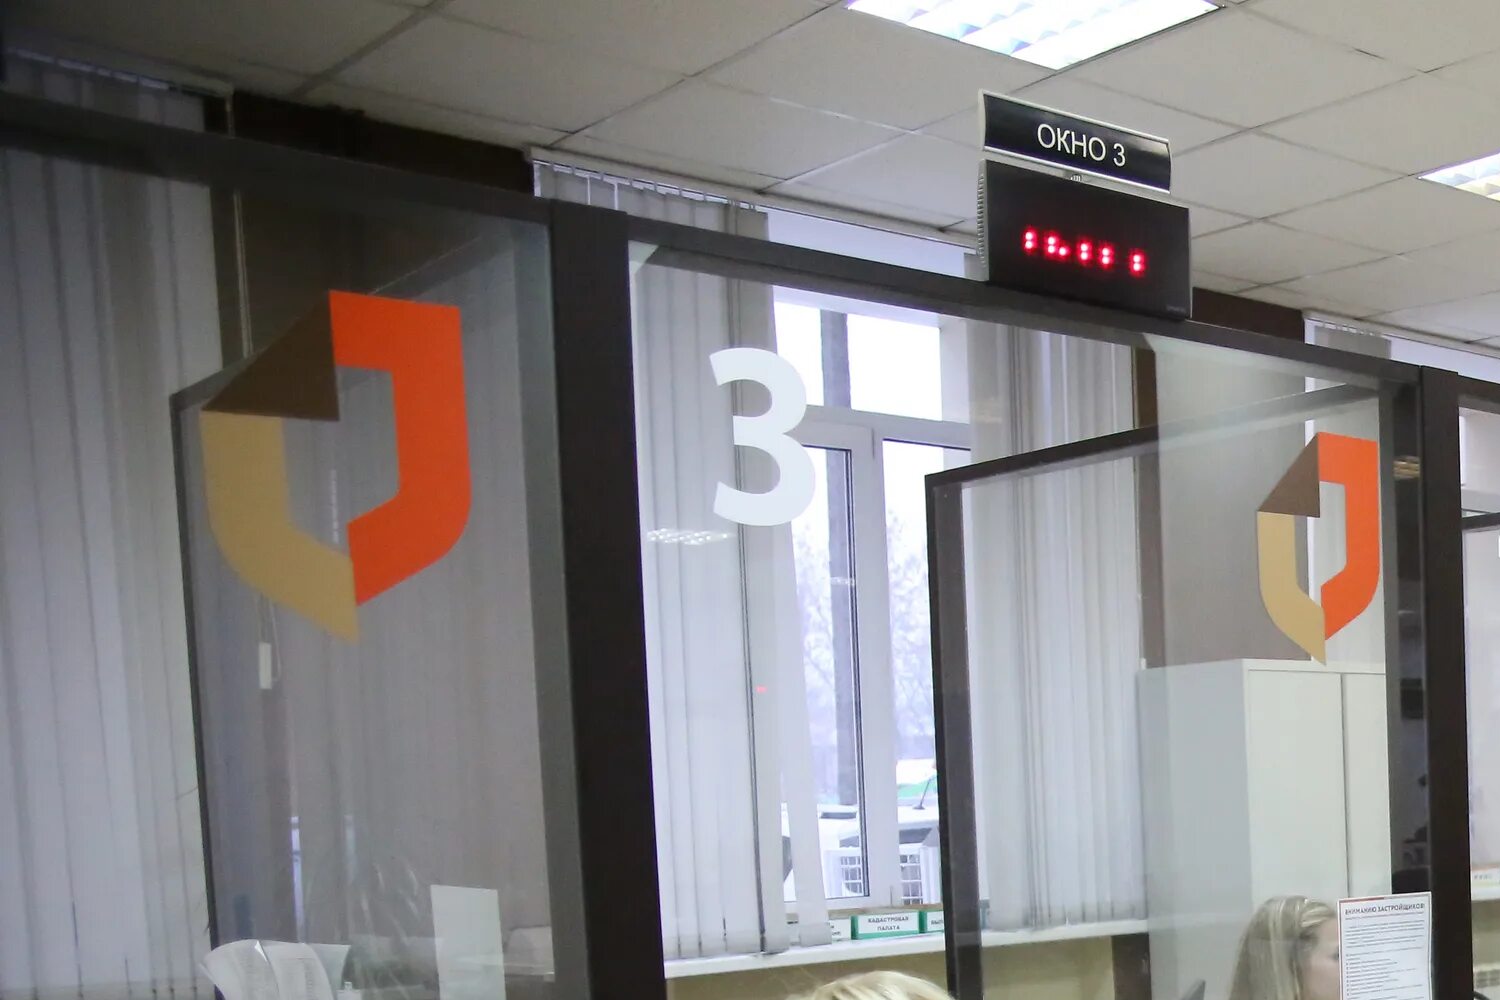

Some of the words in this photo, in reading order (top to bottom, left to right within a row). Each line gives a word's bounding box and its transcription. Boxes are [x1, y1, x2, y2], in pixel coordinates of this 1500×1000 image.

[1037, 123, 1107, 161] ОКНО
[1113, 142, 1126, 167] 3
[709, 347, 816, 526] 3
